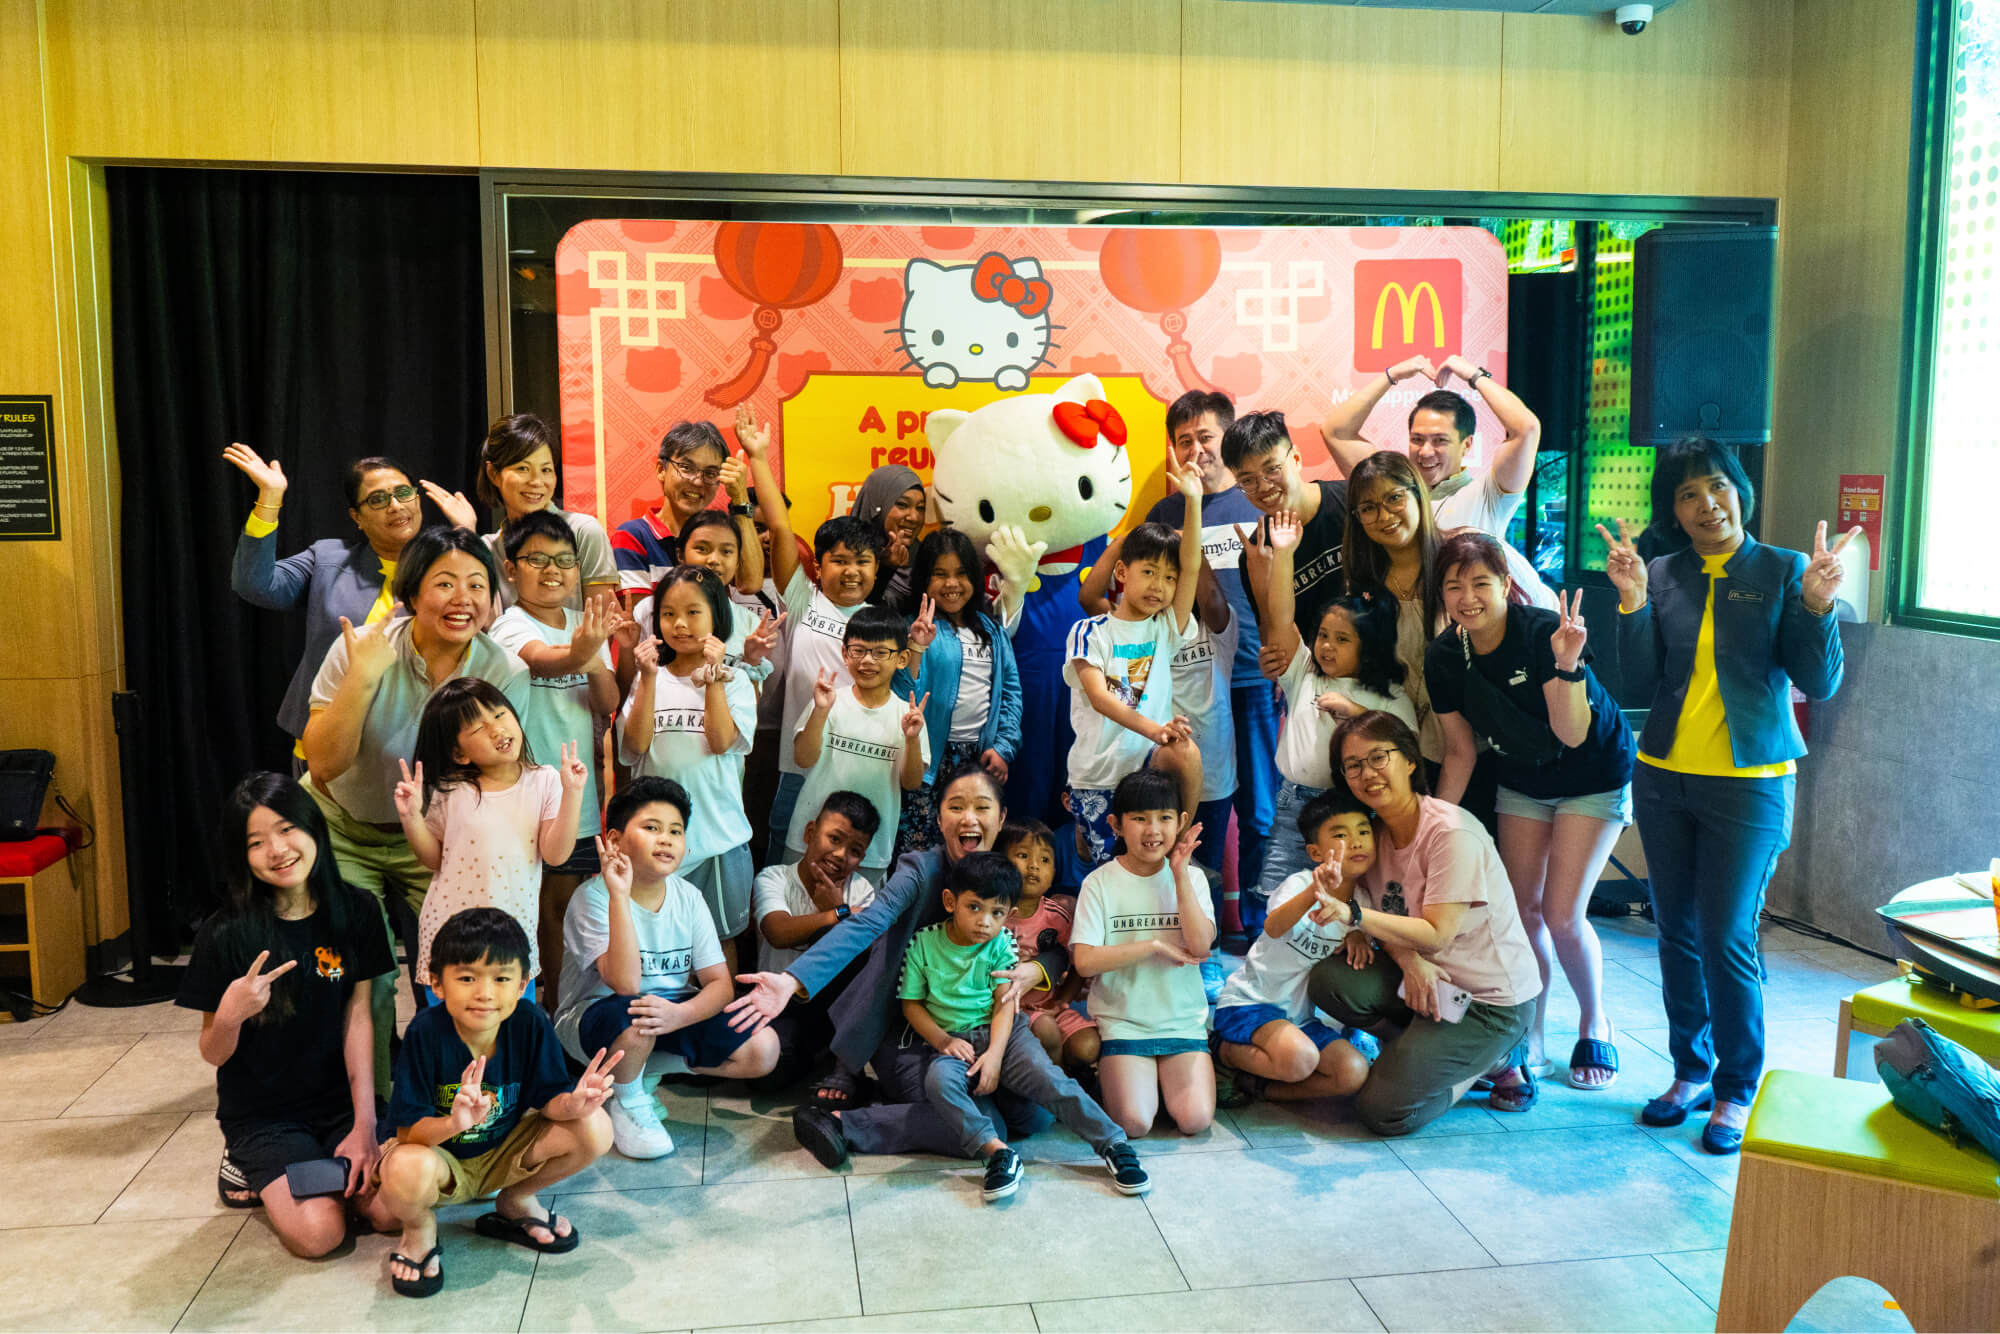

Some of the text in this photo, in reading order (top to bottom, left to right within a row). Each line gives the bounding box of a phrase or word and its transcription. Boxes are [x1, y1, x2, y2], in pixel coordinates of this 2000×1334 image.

[4, 414, 35, 422] RULES
[858, 406, 886, 433] A
[655, 715, 705, 727] REAKA
[1113, 917, 1179, 928] UNBREAKAB
